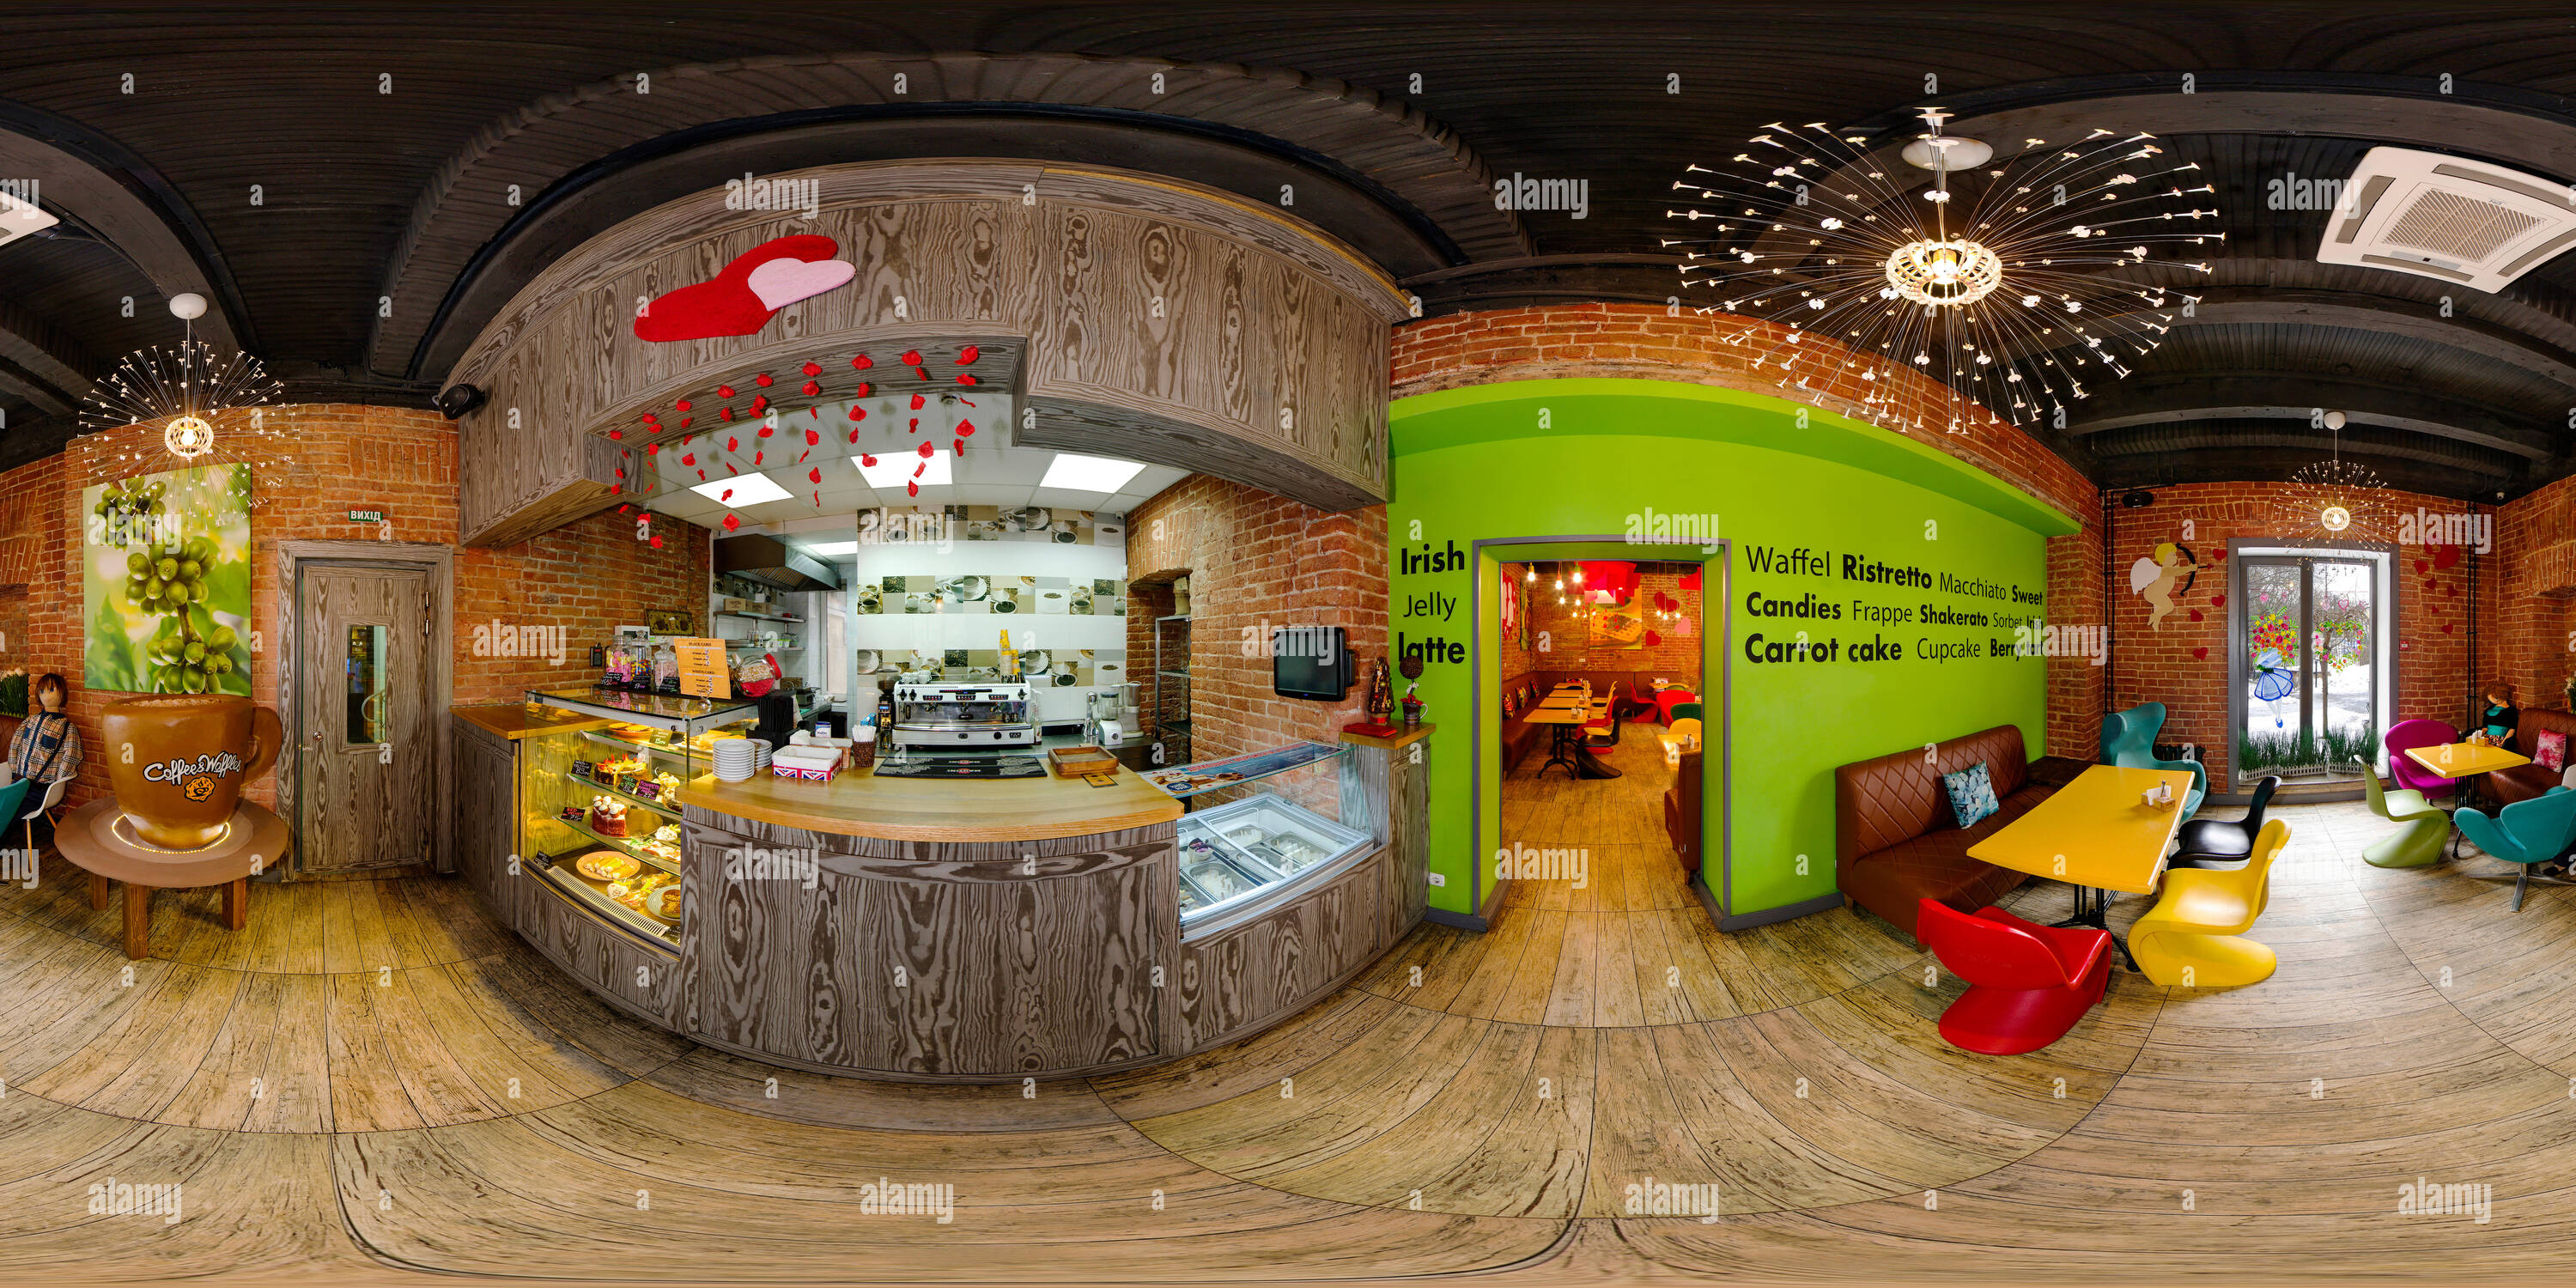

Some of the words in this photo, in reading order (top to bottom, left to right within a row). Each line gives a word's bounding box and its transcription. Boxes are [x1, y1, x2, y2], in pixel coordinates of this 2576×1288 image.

[350, 510, 380, 522] ВИХІД
[1401, 540, 1465, 575] Irish
[1746, 545, 1831, 577] Waffel
[1843, 554, 1932, 589] Ristretto
[1940, 572, 2007, 601] Macchiato
[2012, 585, 2043, 605] Sweet
[1404, 592, 1457, 622] Jelly
[1747, 592, 1842, 620] Candies
[1854, 600, 1912, 627] Frappe
[1920, 605, 1989, 627] Shakerato
[1993, 612, 2023, 629] Sorbet
[1746, 634, 1838, 663] Carrot
[1848, 634, 1902, 662] cake
[1917, 638, 1981, 665] Cupcake
[1990, 639, 2022, 661] Berry
